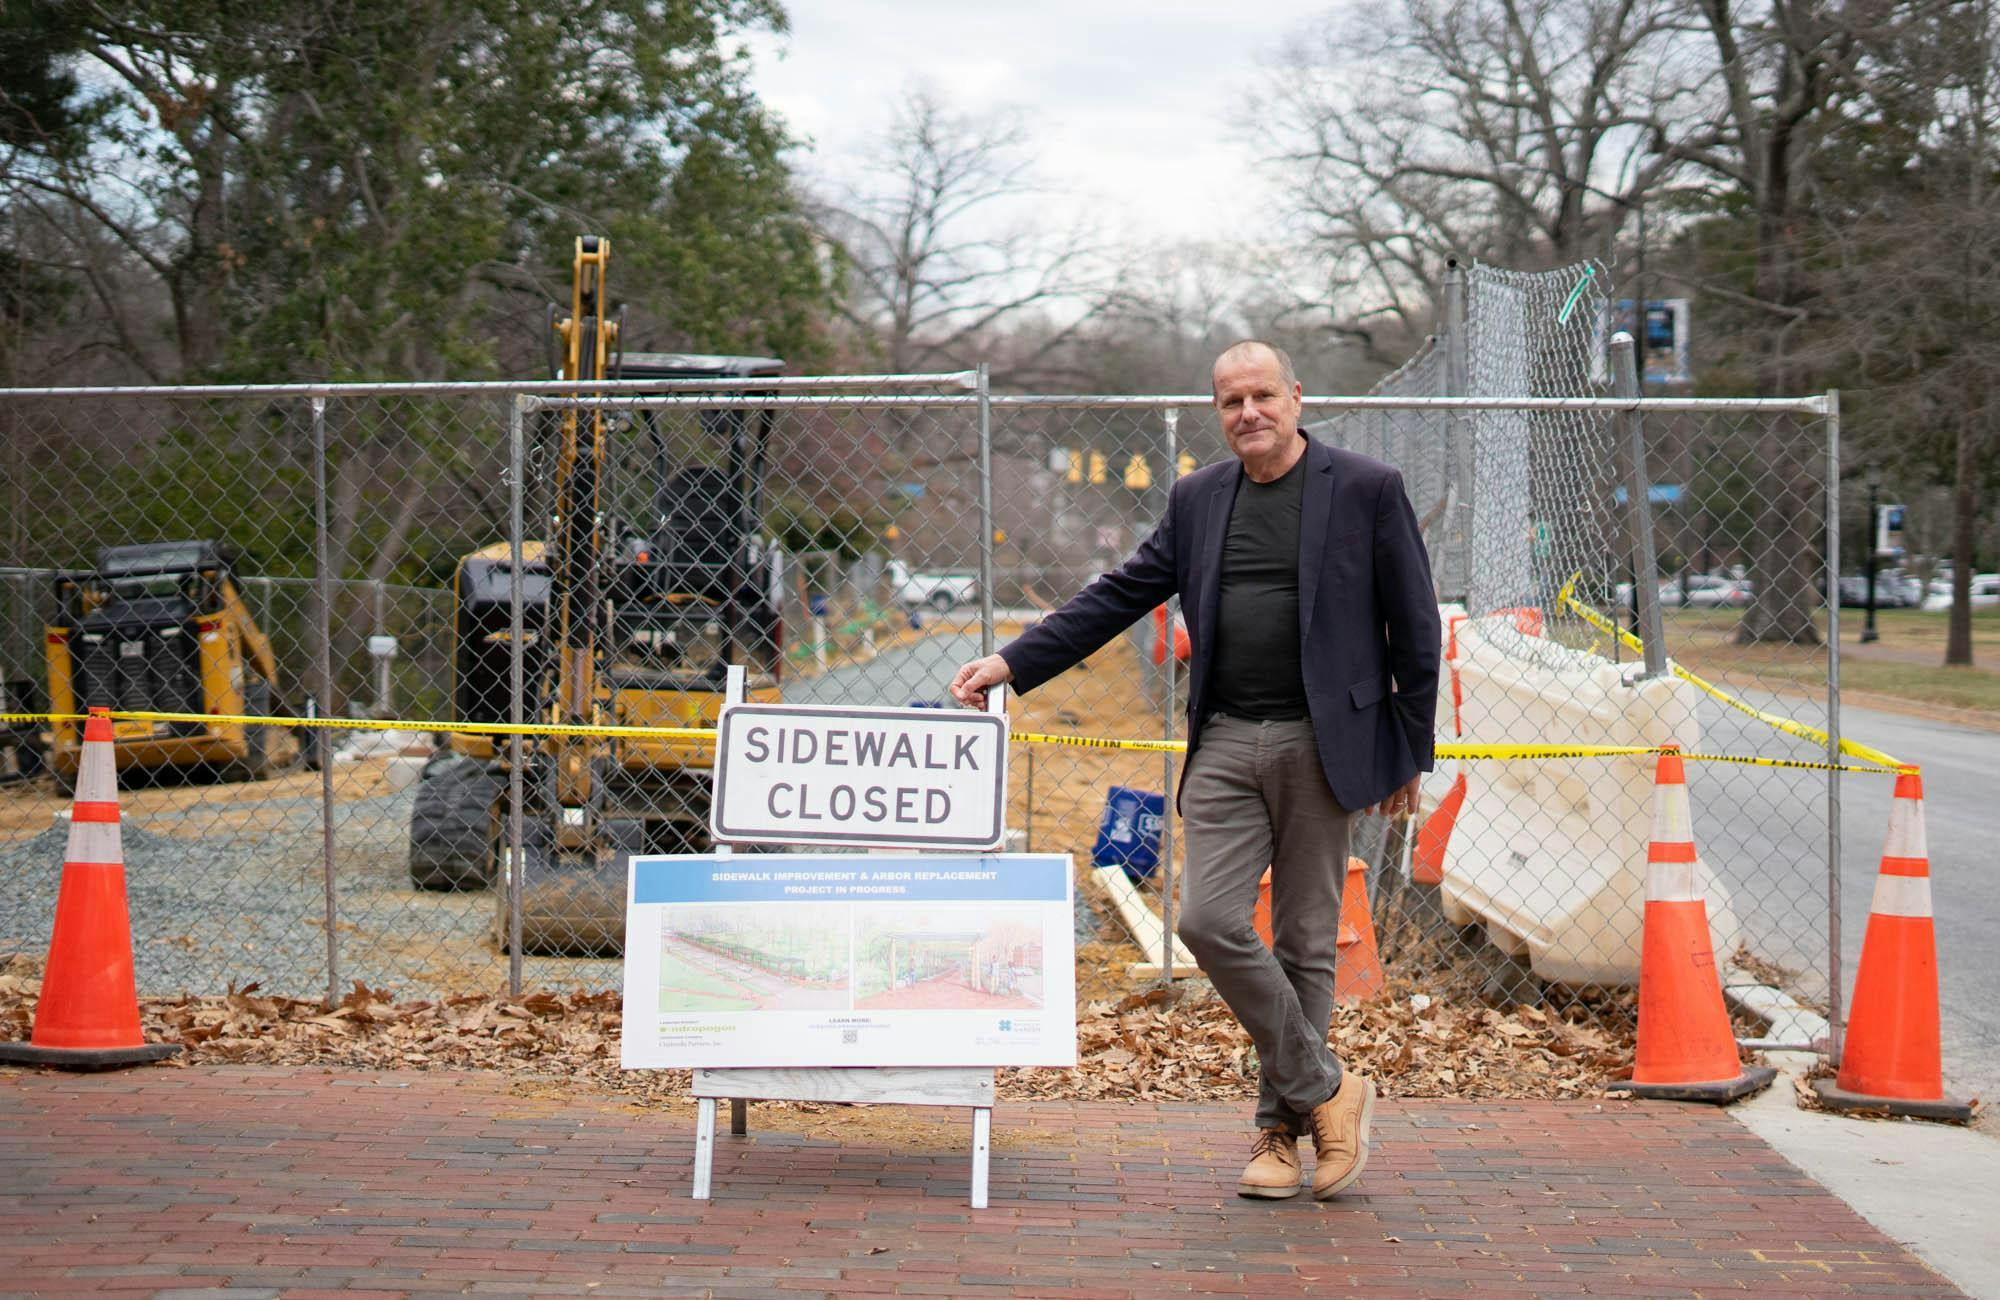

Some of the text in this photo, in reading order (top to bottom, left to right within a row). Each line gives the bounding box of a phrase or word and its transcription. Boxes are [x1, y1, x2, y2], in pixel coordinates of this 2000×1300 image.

[744, 726, 980, 771] SIDEWALK
[767, 782, 952, 824] CLOSED
[712, 871, 998, 881] SIDEWALK IMPROVEMENT & ARBOR REPLACEMENT
[784, 885, 906, 894] PROJECT IN PROGRESS
